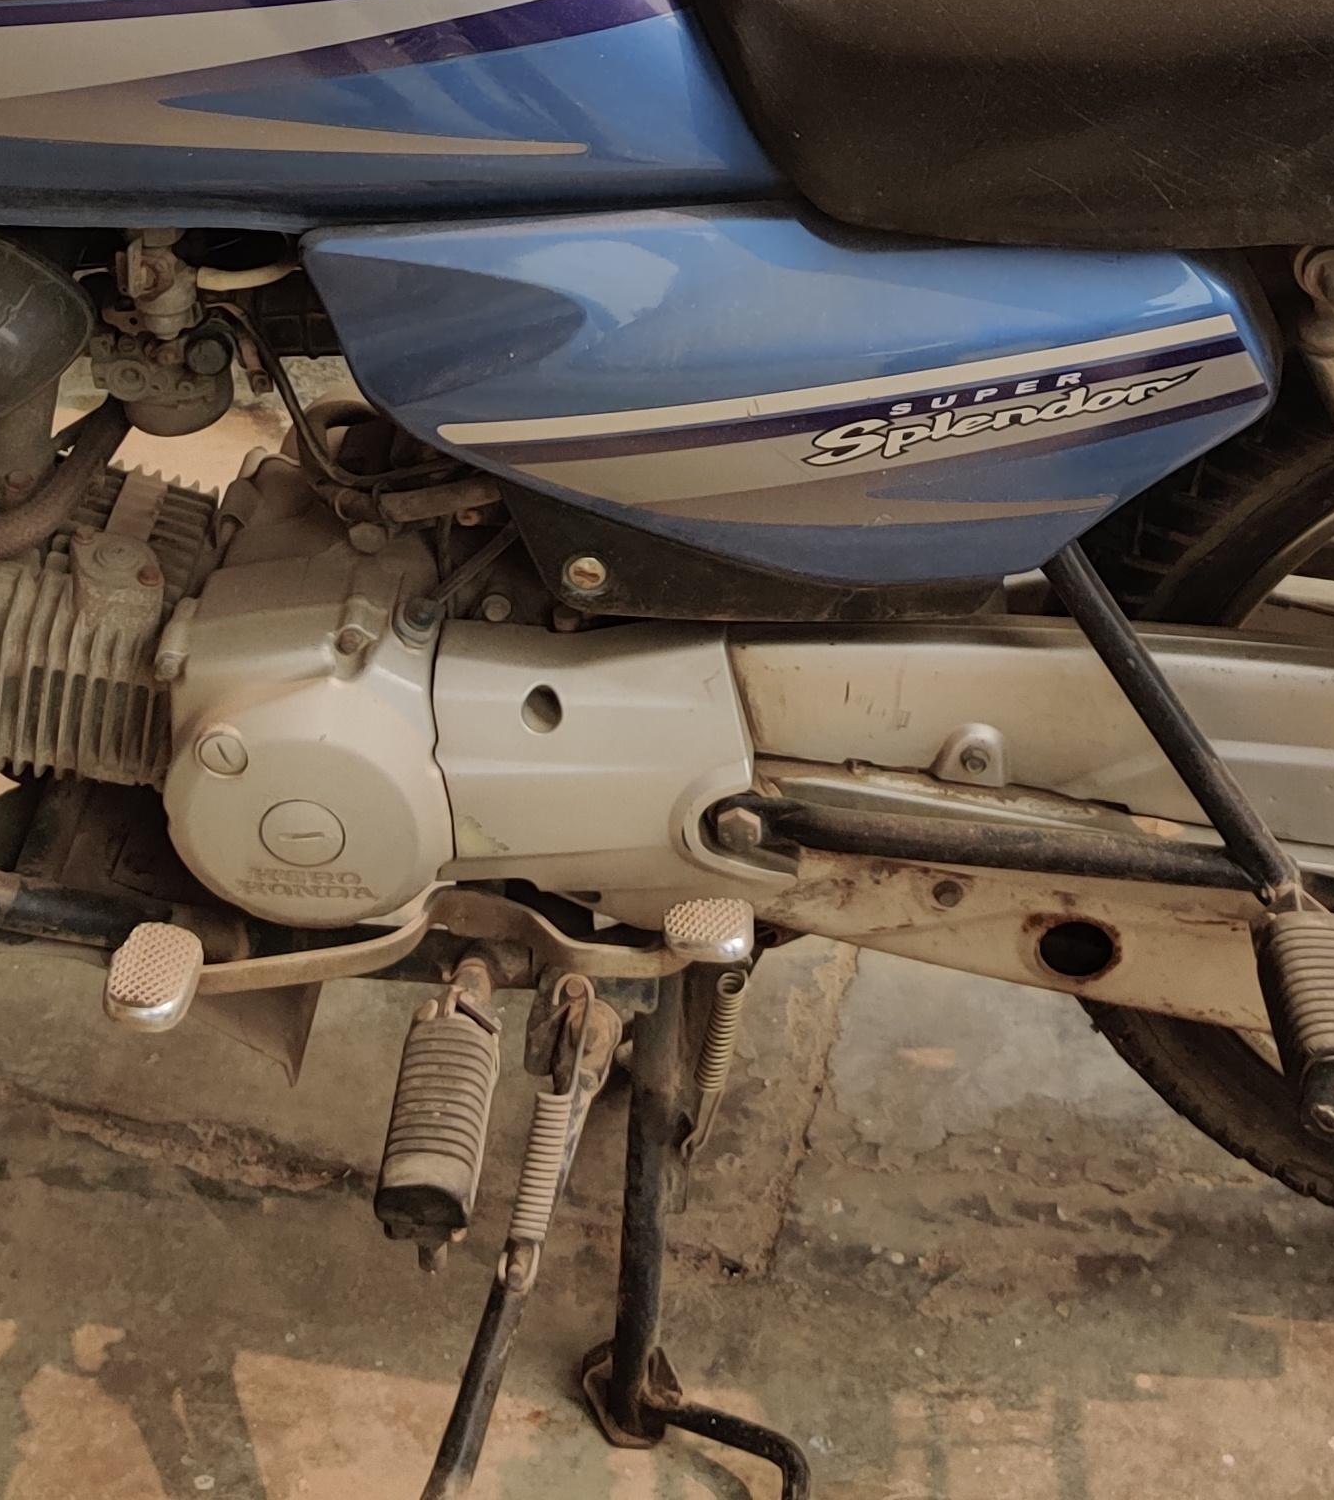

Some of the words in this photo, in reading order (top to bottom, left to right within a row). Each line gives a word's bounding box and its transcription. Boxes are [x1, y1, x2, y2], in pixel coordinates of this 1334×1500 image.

[888, 371, 1084, 416] SUPER
[800, 366, 1204, 467] Splendor
[236, 879, 380, 901] HONDA
[249, 868, 362, 886] HERO
